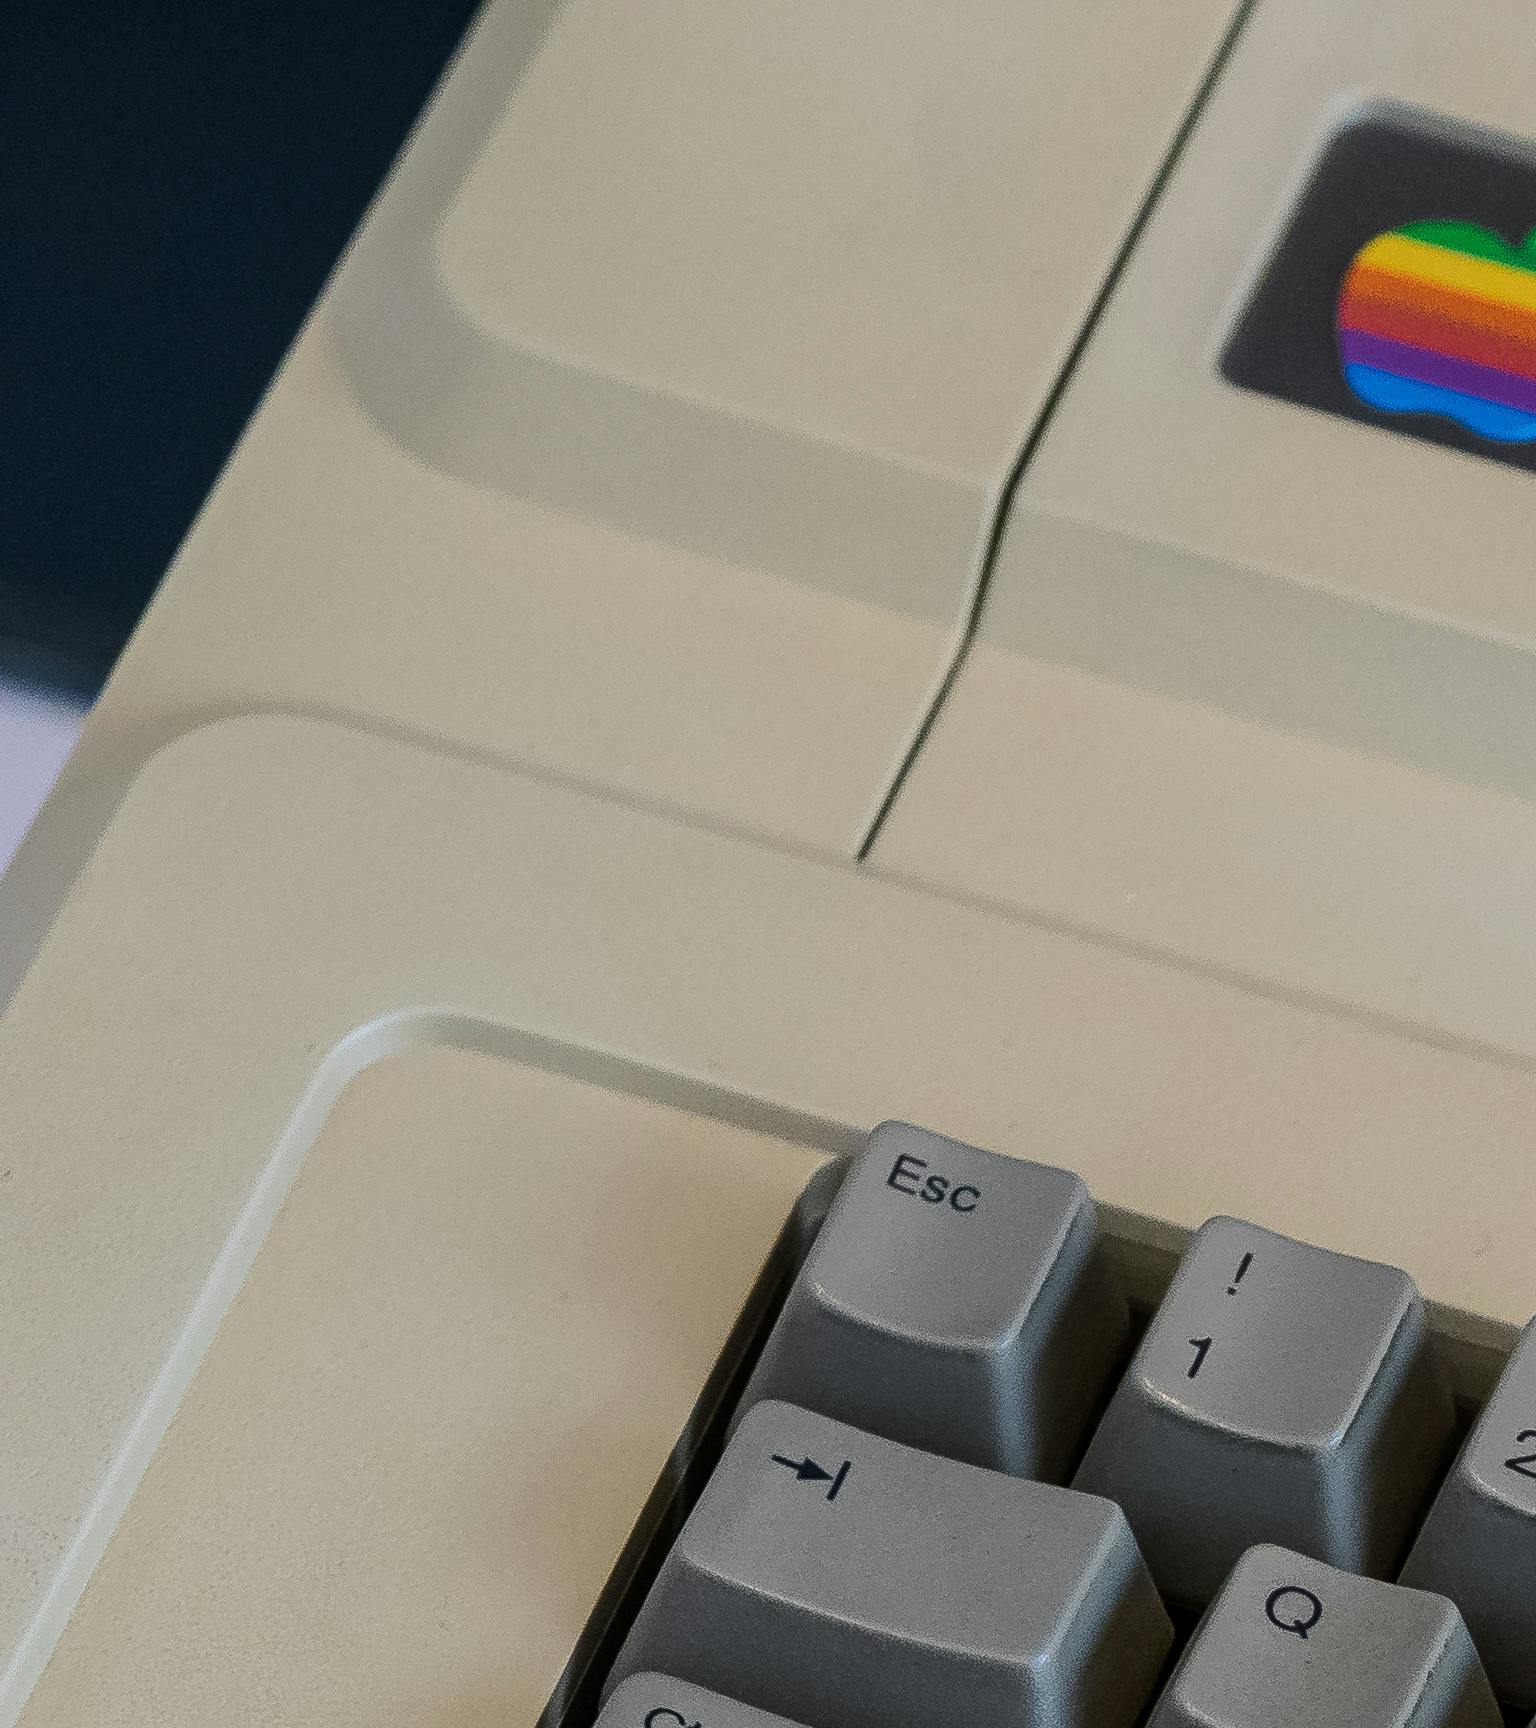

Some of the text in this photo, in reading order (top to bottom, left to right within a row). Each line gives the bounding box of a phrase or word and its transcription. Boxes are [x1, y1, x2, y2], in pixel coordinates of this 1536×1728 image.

[885, 1152, 983, 1215] Esc
[1226, 1251, 1255, 1297] !
[1186, 1336, 1213, 1380] 1
[1264, 1584, 1324, 1641] Q
